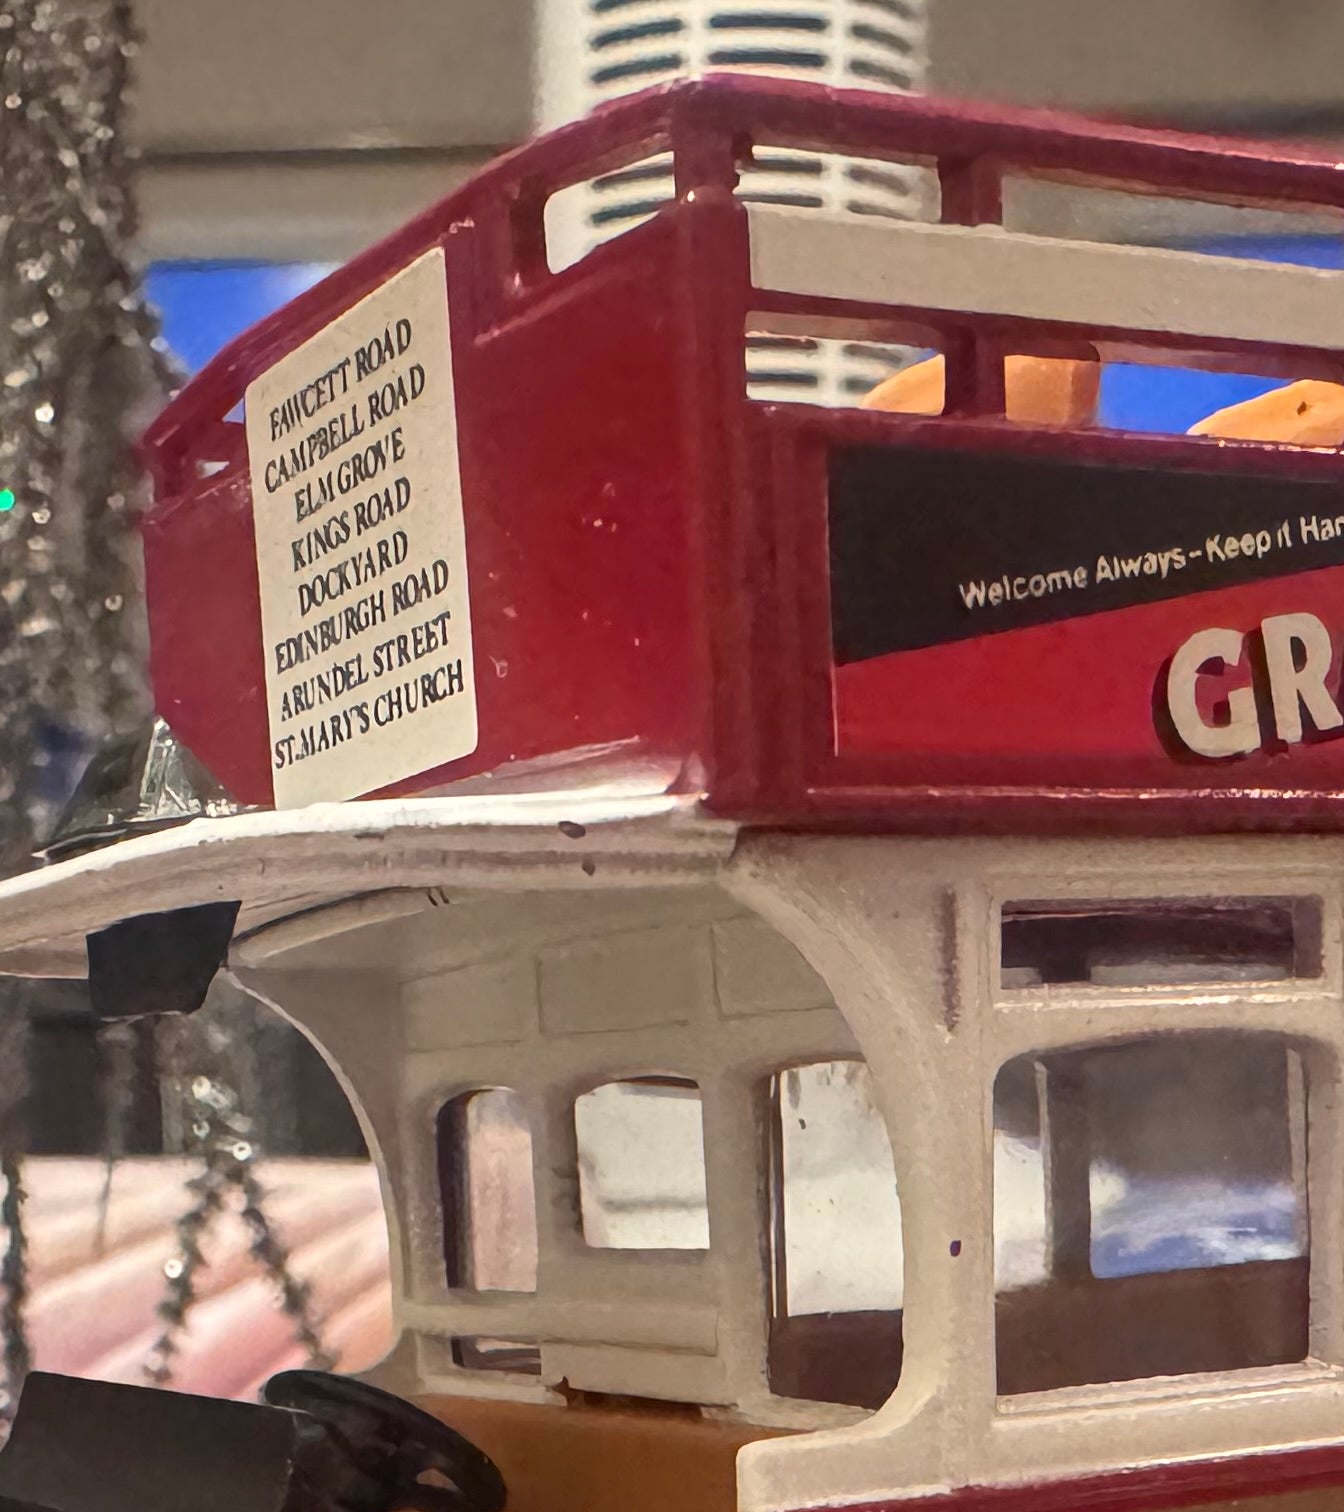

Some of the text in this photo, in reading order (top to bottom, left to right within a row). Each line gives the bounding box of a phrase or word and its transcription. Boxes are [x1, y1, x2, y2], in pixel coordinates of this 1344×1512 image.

[269, 317, 413, 441] FAWCETT ROAD
[264, 363, 426, 494] CAMPBELL ROAD
[294, 427, 405, 522] ELM GROVE
[291, 476, 412, 573] KINGS ROAD
[959, 567, 1088, 610] Welcome
[1277, 518, 1293, 549] it
[274, 559, 450, 675] EDINBURGH ROAD
[297, 529, 409, 618] DOCKYARD
[281, 612, 451, 722] ARUNDEL STREET
[373, 658, 465, 727] CHURCH
